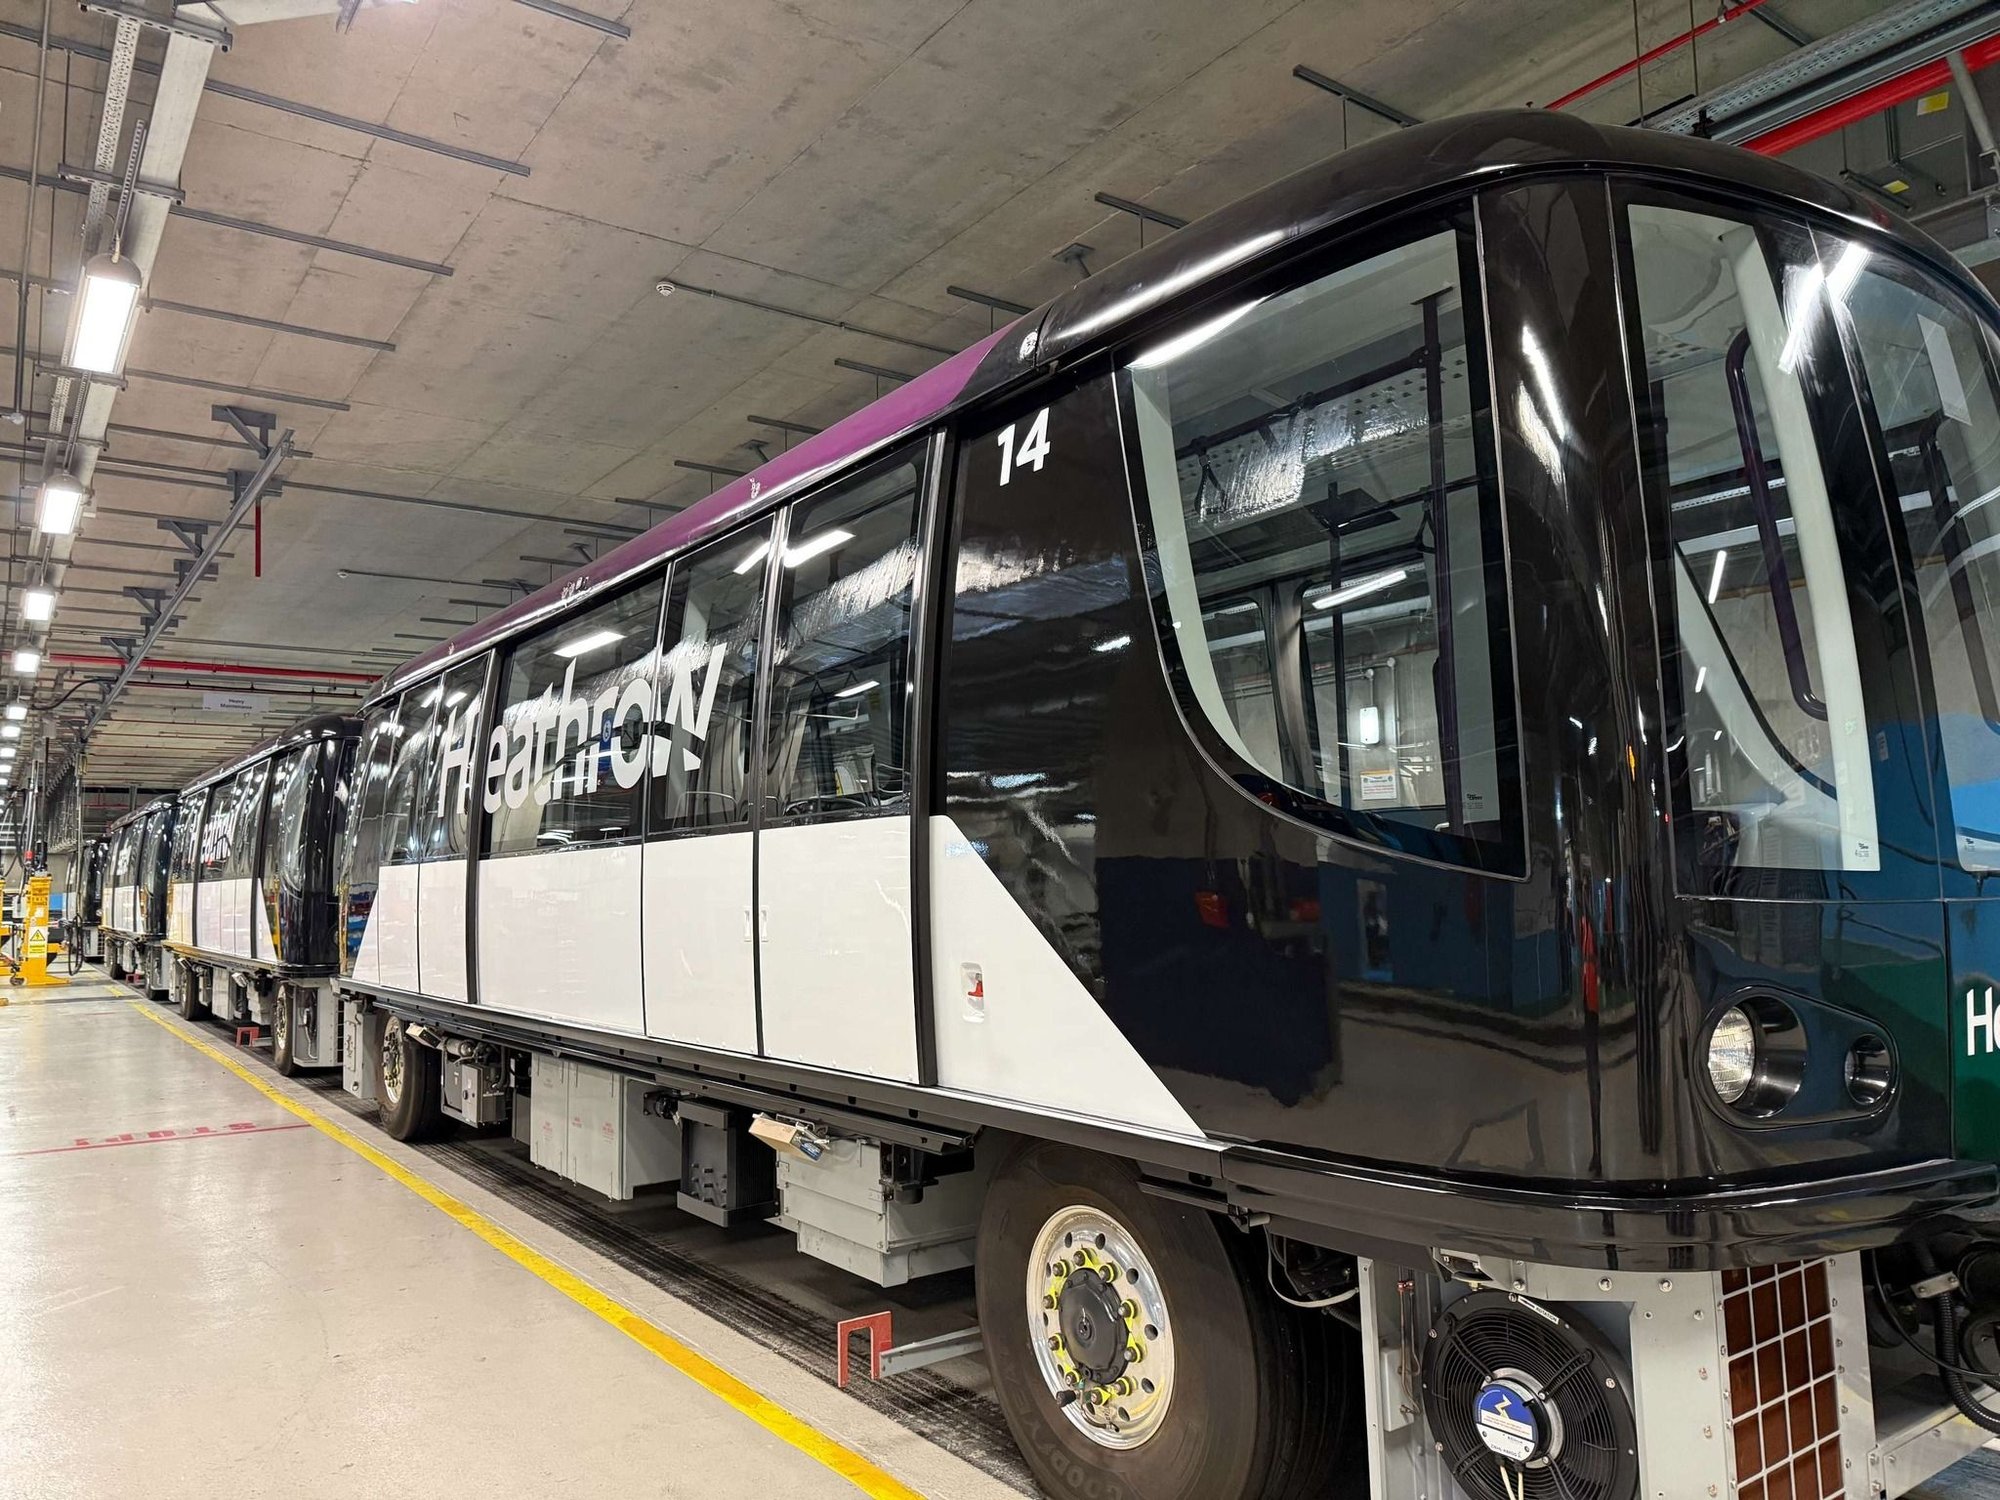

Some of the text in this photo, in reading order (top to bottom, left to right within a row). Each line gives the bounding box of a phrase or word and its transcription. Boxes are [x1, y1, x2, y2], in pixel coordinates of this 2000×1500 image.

[997, 406, 1051, 487] 14
[437, 642, 727, 818] Heathrow
[1966, 986, 2000, 1056] H
